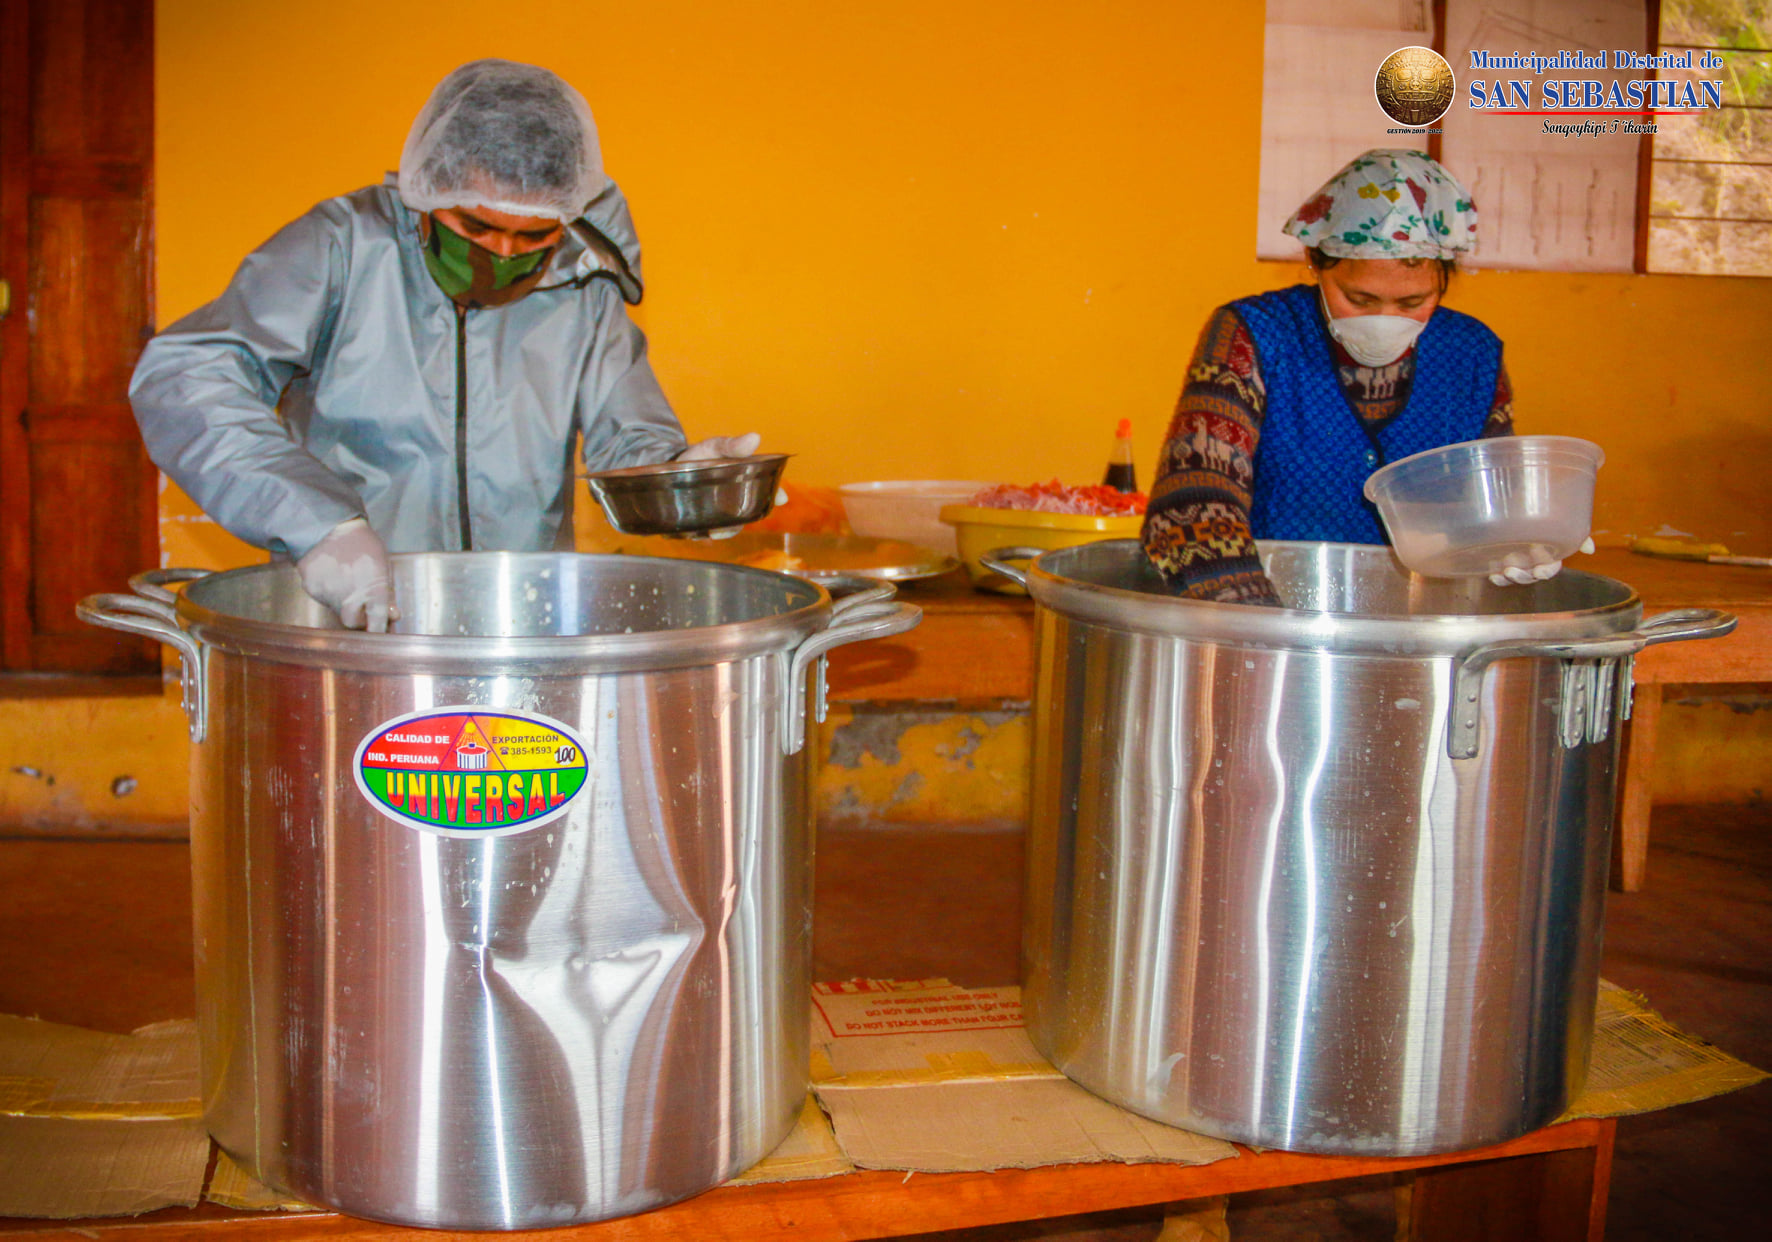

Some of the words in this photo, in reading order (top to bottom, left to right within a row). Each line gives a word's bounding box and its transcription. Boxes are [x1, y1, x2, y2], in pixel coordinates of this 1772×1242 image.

[385, 734, 431, 744] CALIDAD
[435, 735, 450, 744] DE
[510, 746, 552, 755] 385-1593
[554, 747, 576, 764] 100
[368, 752, 387, 762] IND.
[391, 754, 439, 764] PERUANA
[386, 771, 566, 823] UNIVERSAL
[886, 1020, 918, 1028] STACK
